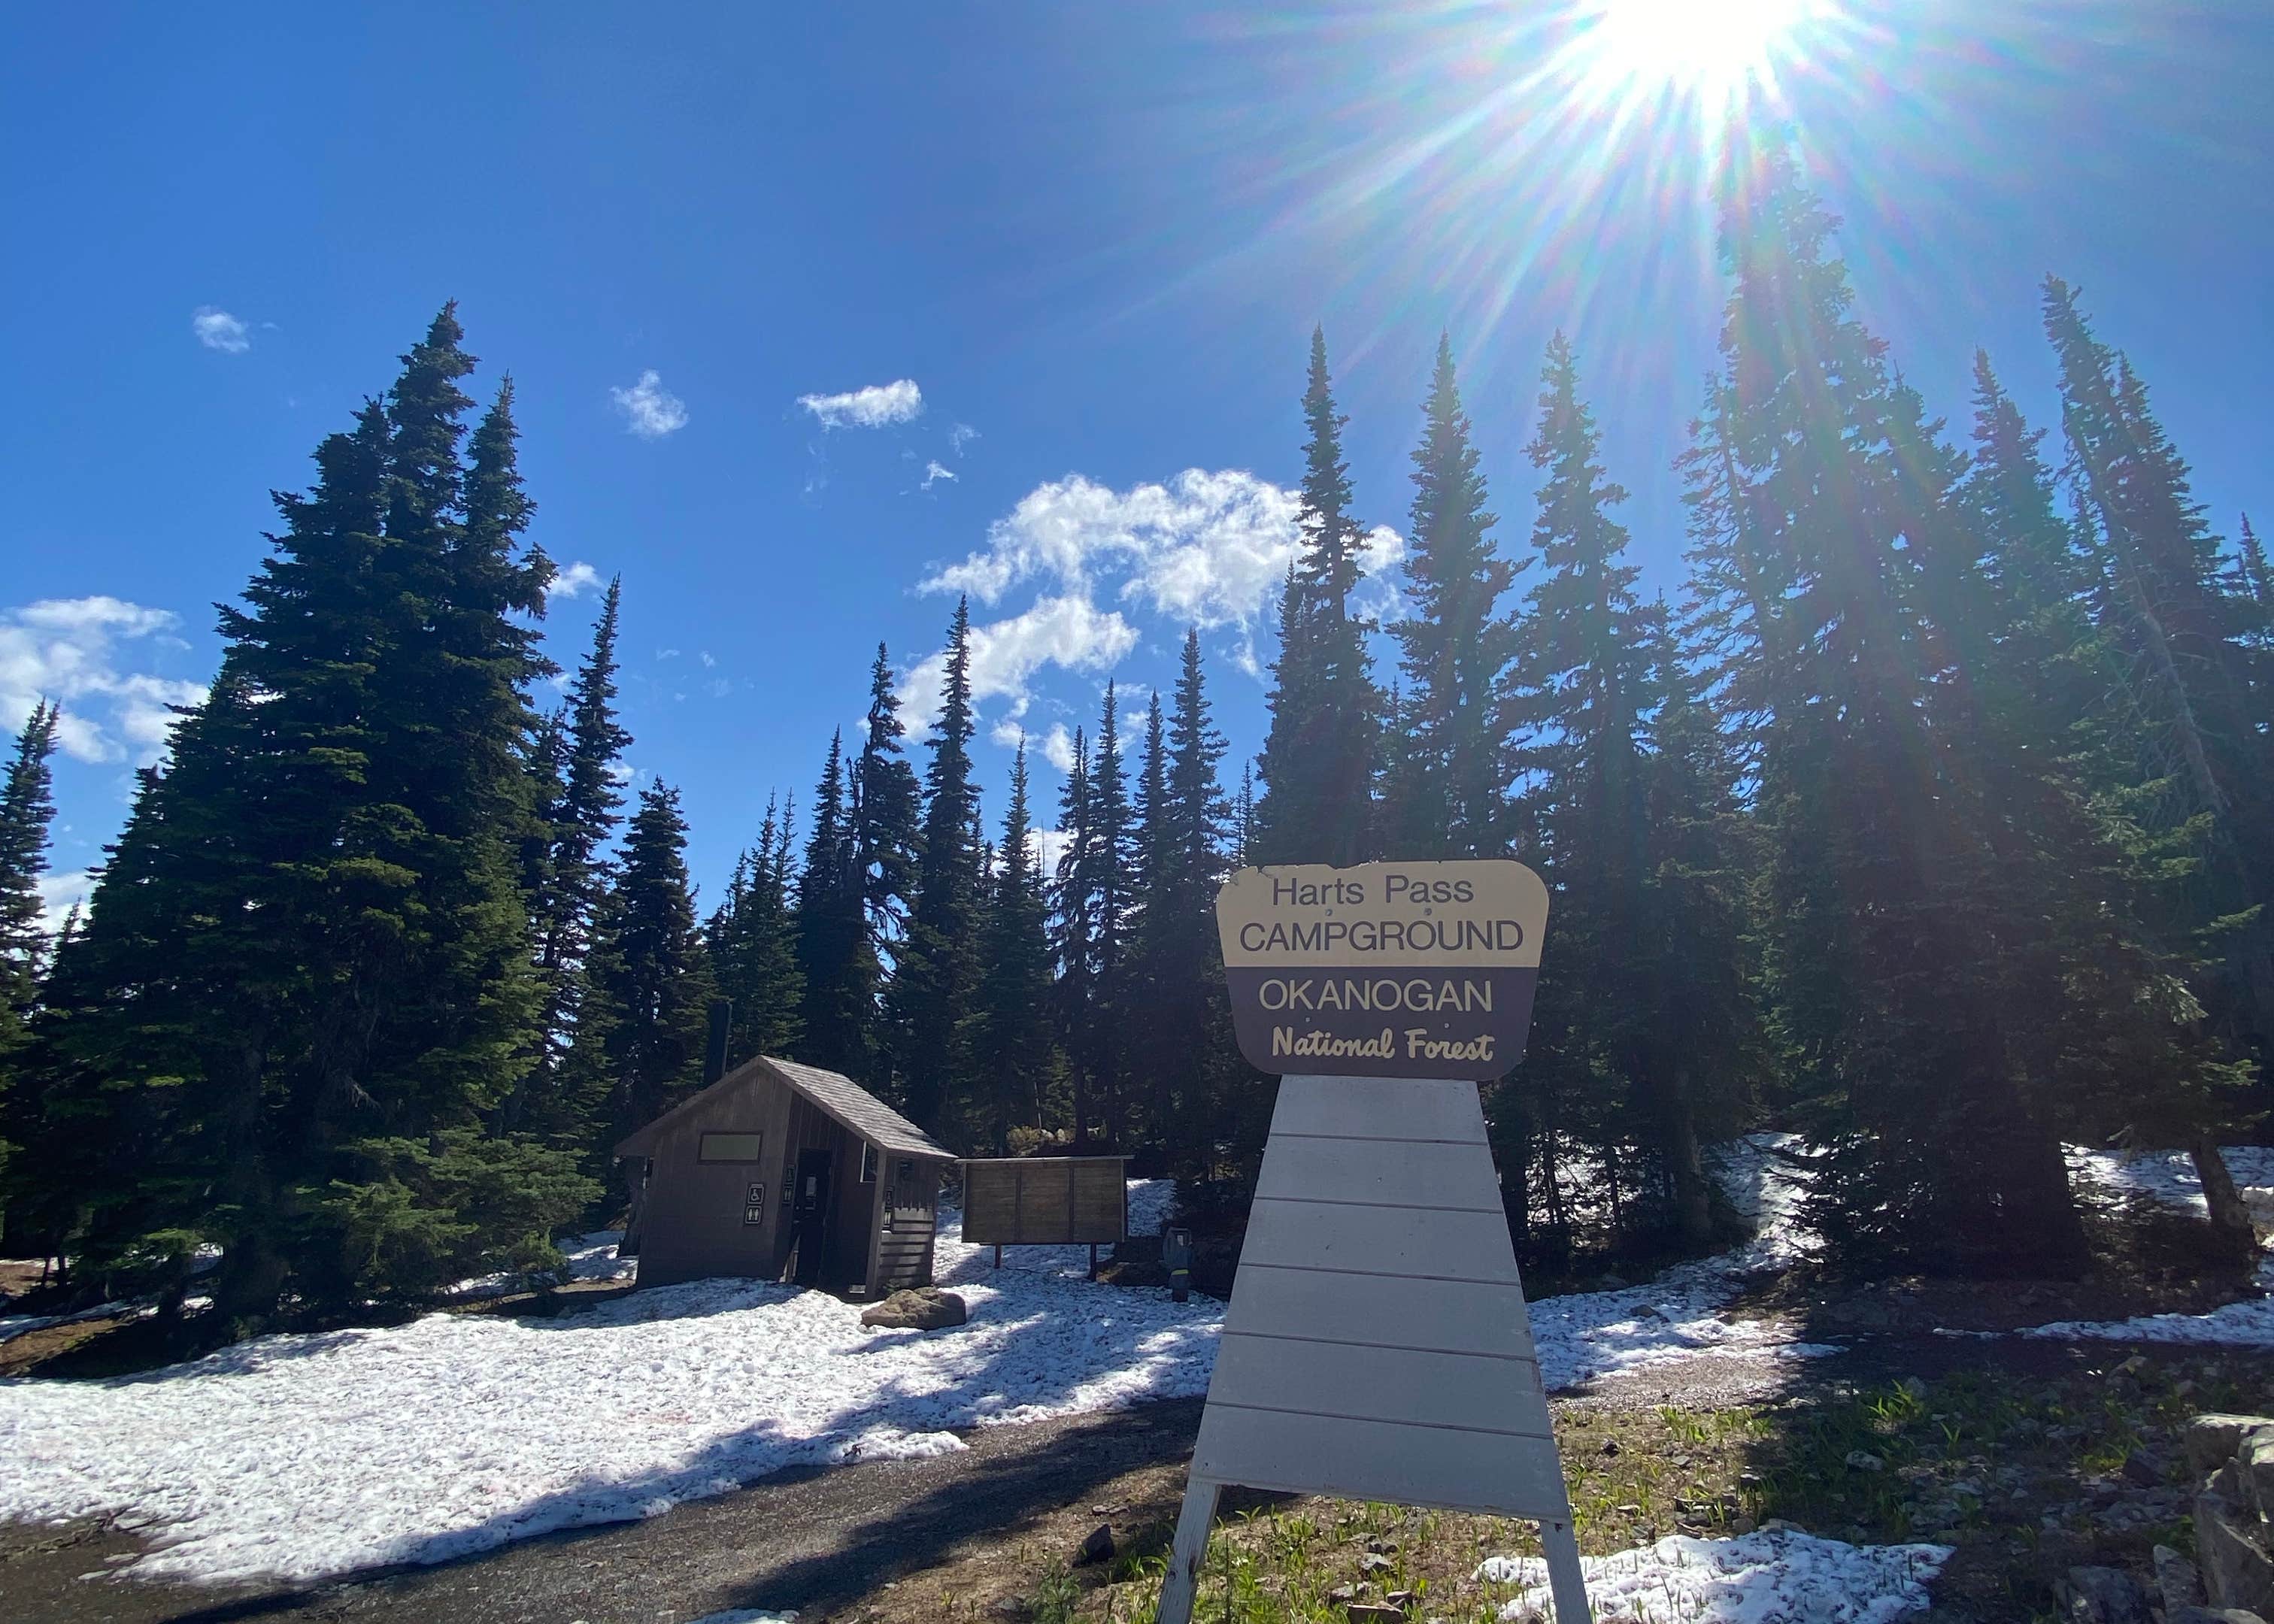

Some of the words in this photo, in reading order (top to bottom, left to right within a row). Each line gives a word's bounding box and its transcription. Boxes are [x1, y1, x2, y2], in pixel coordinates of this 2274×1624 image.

[1272, 877, 1365, 906] Harts
[1385, 875, 1475, 904] Pass
[1239, 920, 1524, 952] CAMPGROUND
[1259, 980, 1493, 1012] OKANOGAN
[1272, 1026, 1395, 1059] National
[1404, 1029, 1495, 1062] Forest
